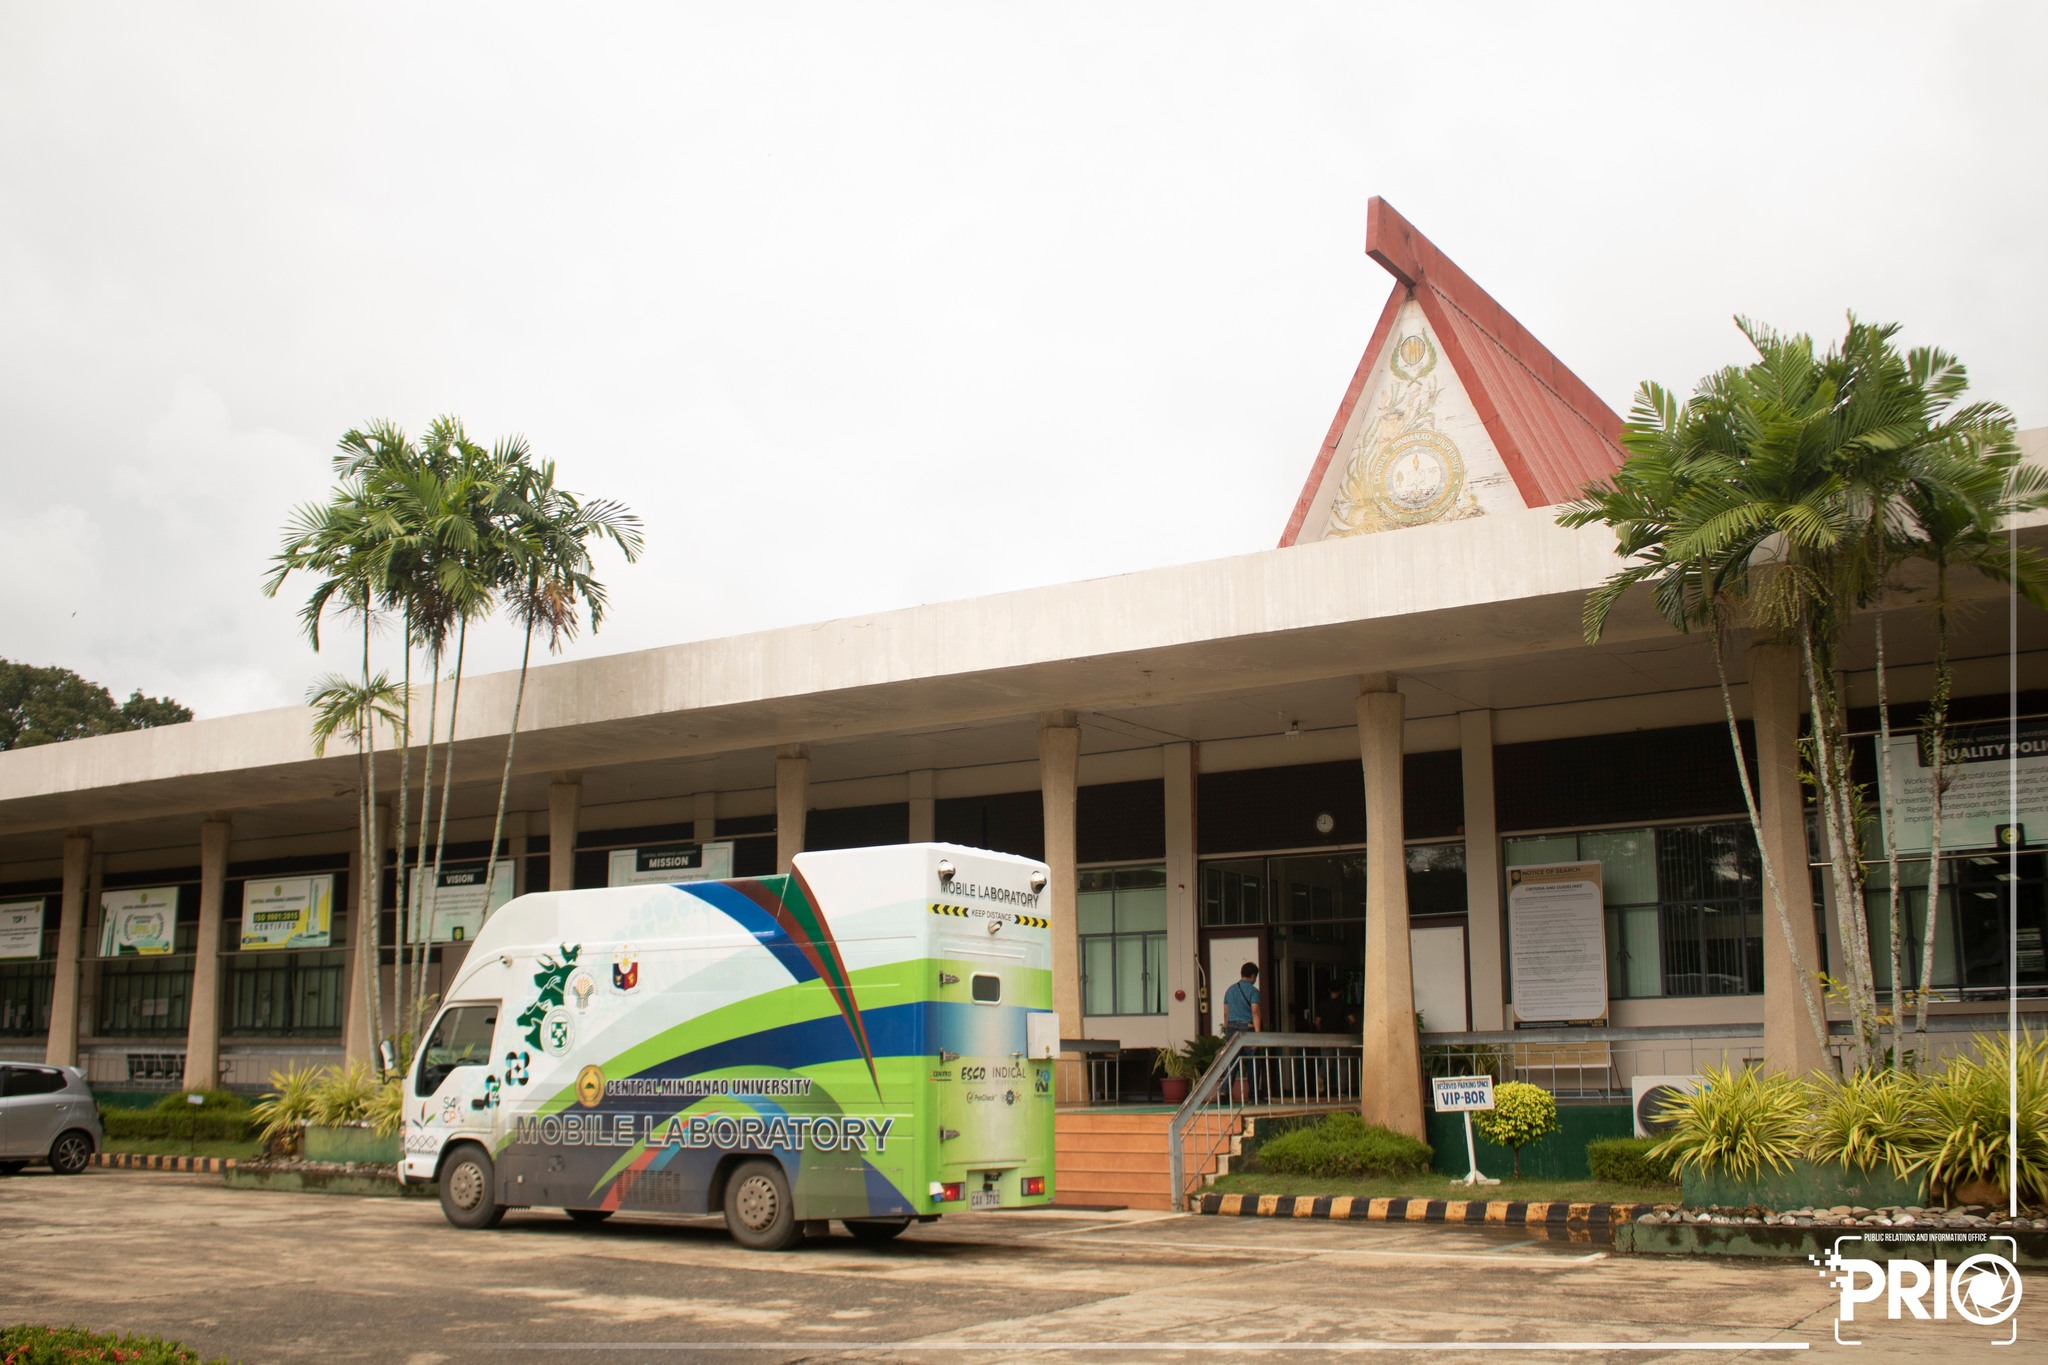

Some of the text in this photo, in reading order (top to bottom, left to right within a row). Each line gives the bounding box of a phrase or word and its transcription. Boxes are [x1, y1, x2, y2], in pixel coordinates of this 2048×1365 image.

[2009, 740, 2048, 755] POLI
[648, 856, 689, 869] MISSION
[1556, 865, 1581, 874] SEARCH
[446, 874, 475, 885] VISION
[941, 880, 1039, 909] MOBILE LABORATORY
[255, 913, 266, 922] ISO
[971, 908, 1012, 922] KEEP DISTANCE
[254, 922, 297, 932] CERTIFIED
[961, 1066, 986, 1081] ESCO
[992, 1066, 1026, 1079] INDICAL
[605, 1078, 658, 1096] CENTRAL
[660, 1078, 729, 1096] MINDANAO
[732, 1077, 812, 1096] UNIVERSITY
[1437, 1080, 1489, 1090] RESERVED PARKING SPACE
[516, 1114, 895, 1151] MOBILE LABORATORY
